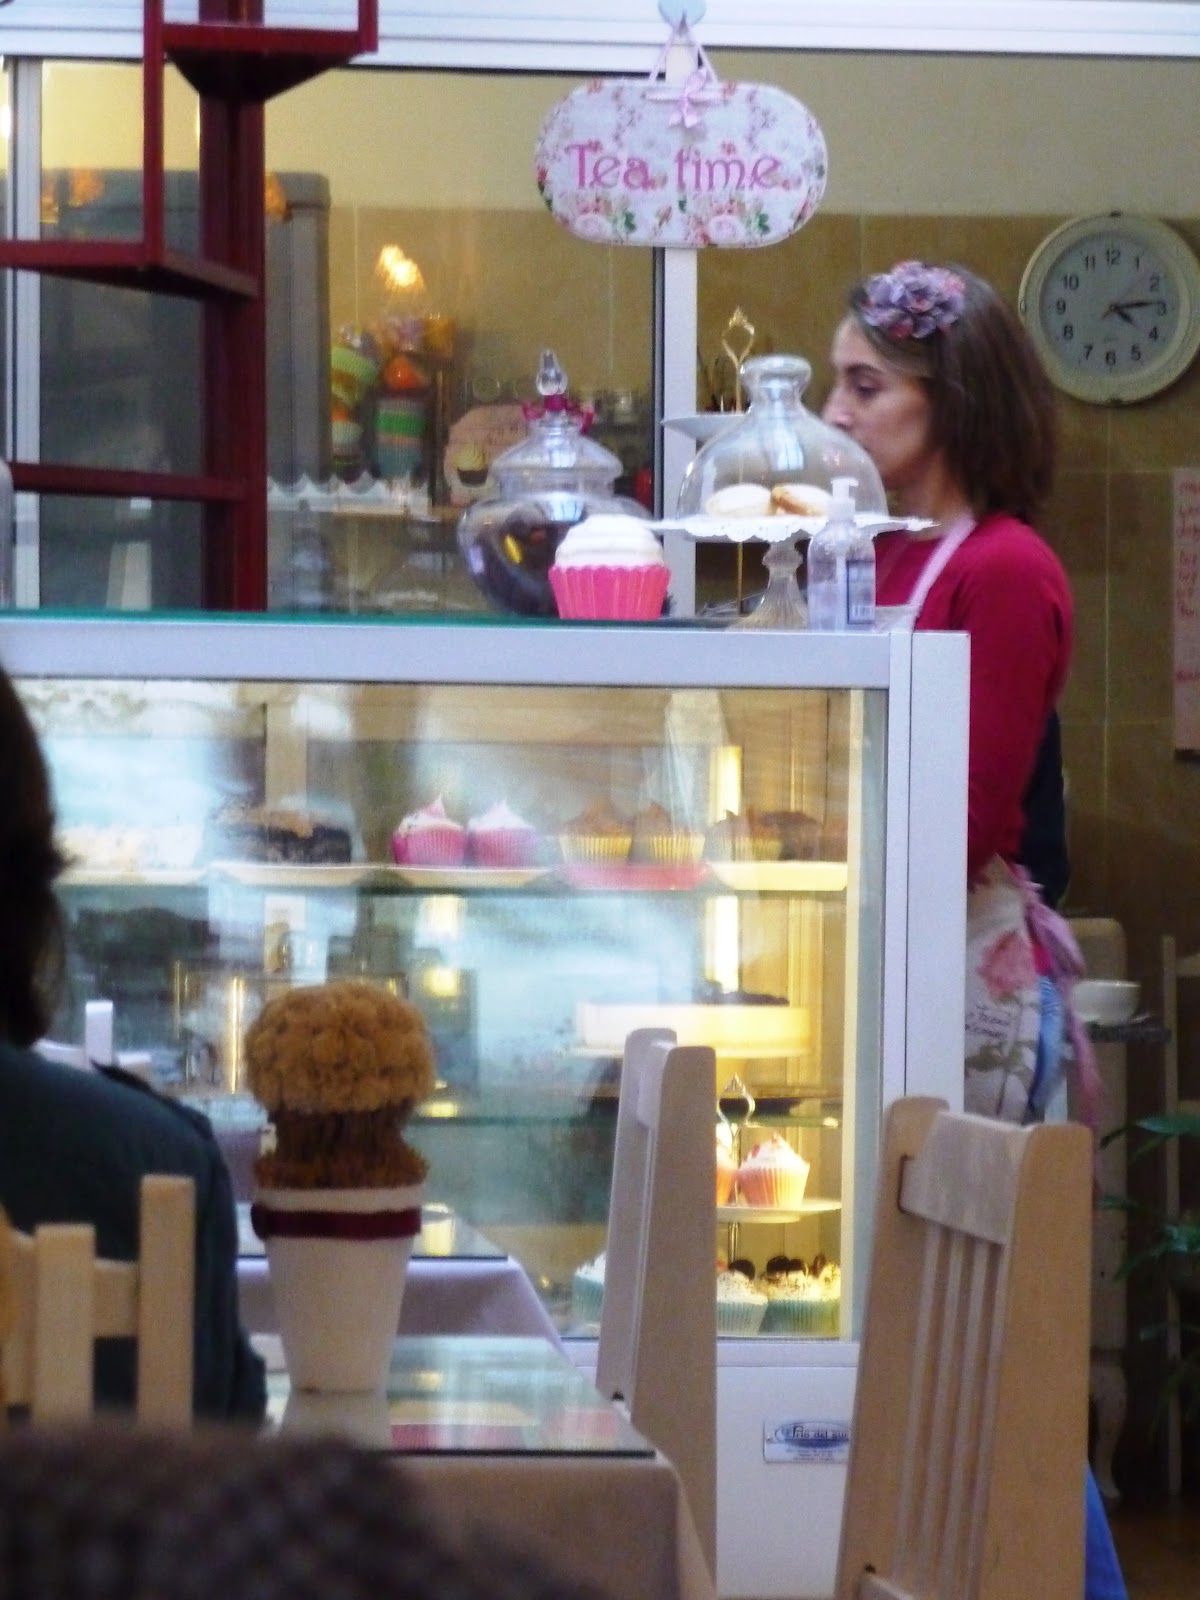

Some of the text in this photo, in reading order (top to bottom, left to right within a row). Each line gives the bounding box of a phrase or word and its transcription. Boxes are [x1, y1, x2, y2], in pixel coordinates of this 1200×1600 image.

[564, 143, 783, 192] Tea time
[1084, 255, 1096, 271] 11
[1105, 247, 1121, 266] 12
[1135, 256, 1140, 270] 1
[1063, 274, 1079, 290] 10
[1150, 276, 1160, 292] 2
[1056, 298, 1066, 315] 9
[1155, 300, 1167, 317] 3
[1063, 325, 1073, 341] 8
[1148, 325, 1159, 342] 4
[1084, 344, 1094, 360] 7
[1105, 351, 1116, 366] 6
[1131, 344, 1141, 361] 5
